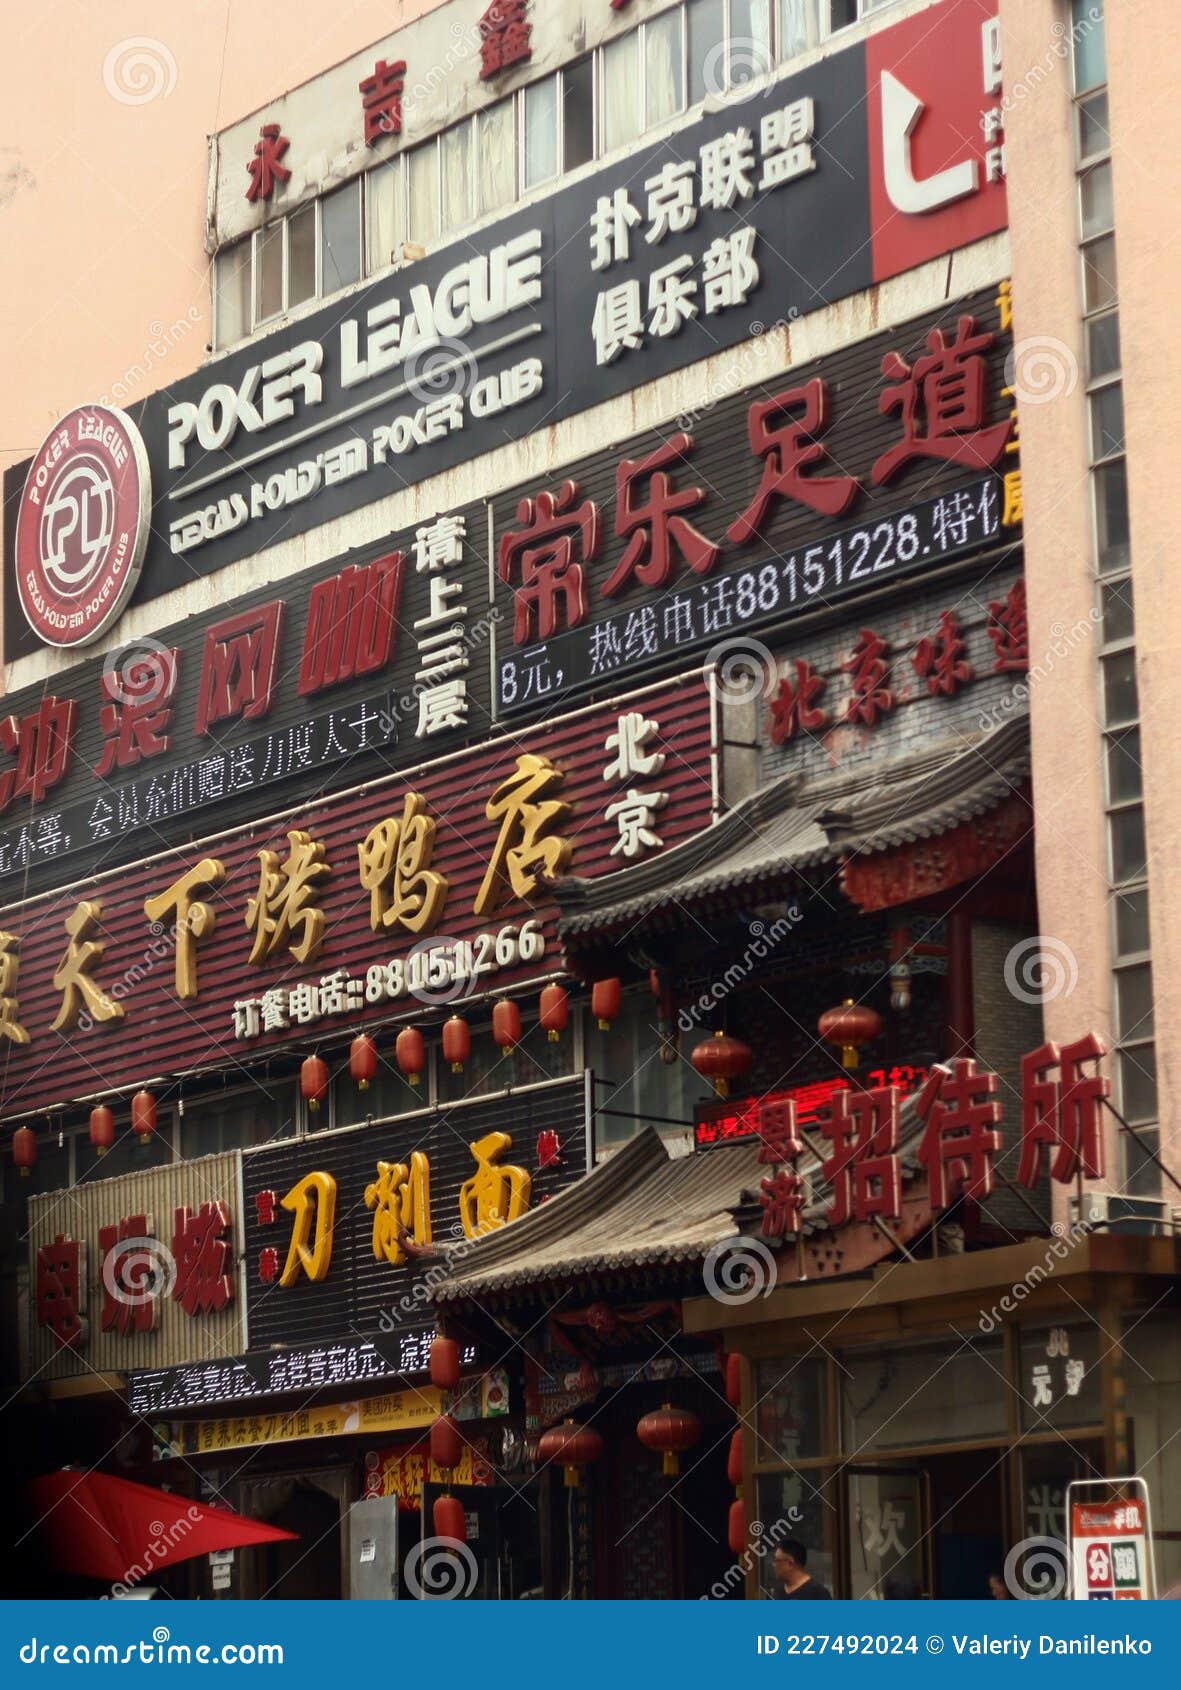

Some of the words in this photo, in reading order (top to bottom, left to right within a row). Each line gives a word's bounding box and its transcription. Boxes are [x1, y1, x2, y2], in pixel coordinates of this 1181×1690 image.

[246, 0, 622, 200] 永吉鑫
[590, 97, 816, 272] 扑克联盟
[168, 339, 325, 470] POKER
[339, 228, 542, 388] LEAGUE
[591, 226, 759, 365] 俱乐部
[29, 429, 71, 505] POKER
[78, 416, 129, 469] LEAGUE
[372, 392, 465, 464] POKER
[469, 357, 543, 418] CLUB
[500, 315, 1014, 645] 常乐足道
[112, 532, 129, 572] CLUB
[412, 515, 469, 739] 请上三层
[603, 712, 669, 858] 北京
[279, 1131, 533, 1288] 刀削面
[822, 1032, 1112, 1227] 招待所
